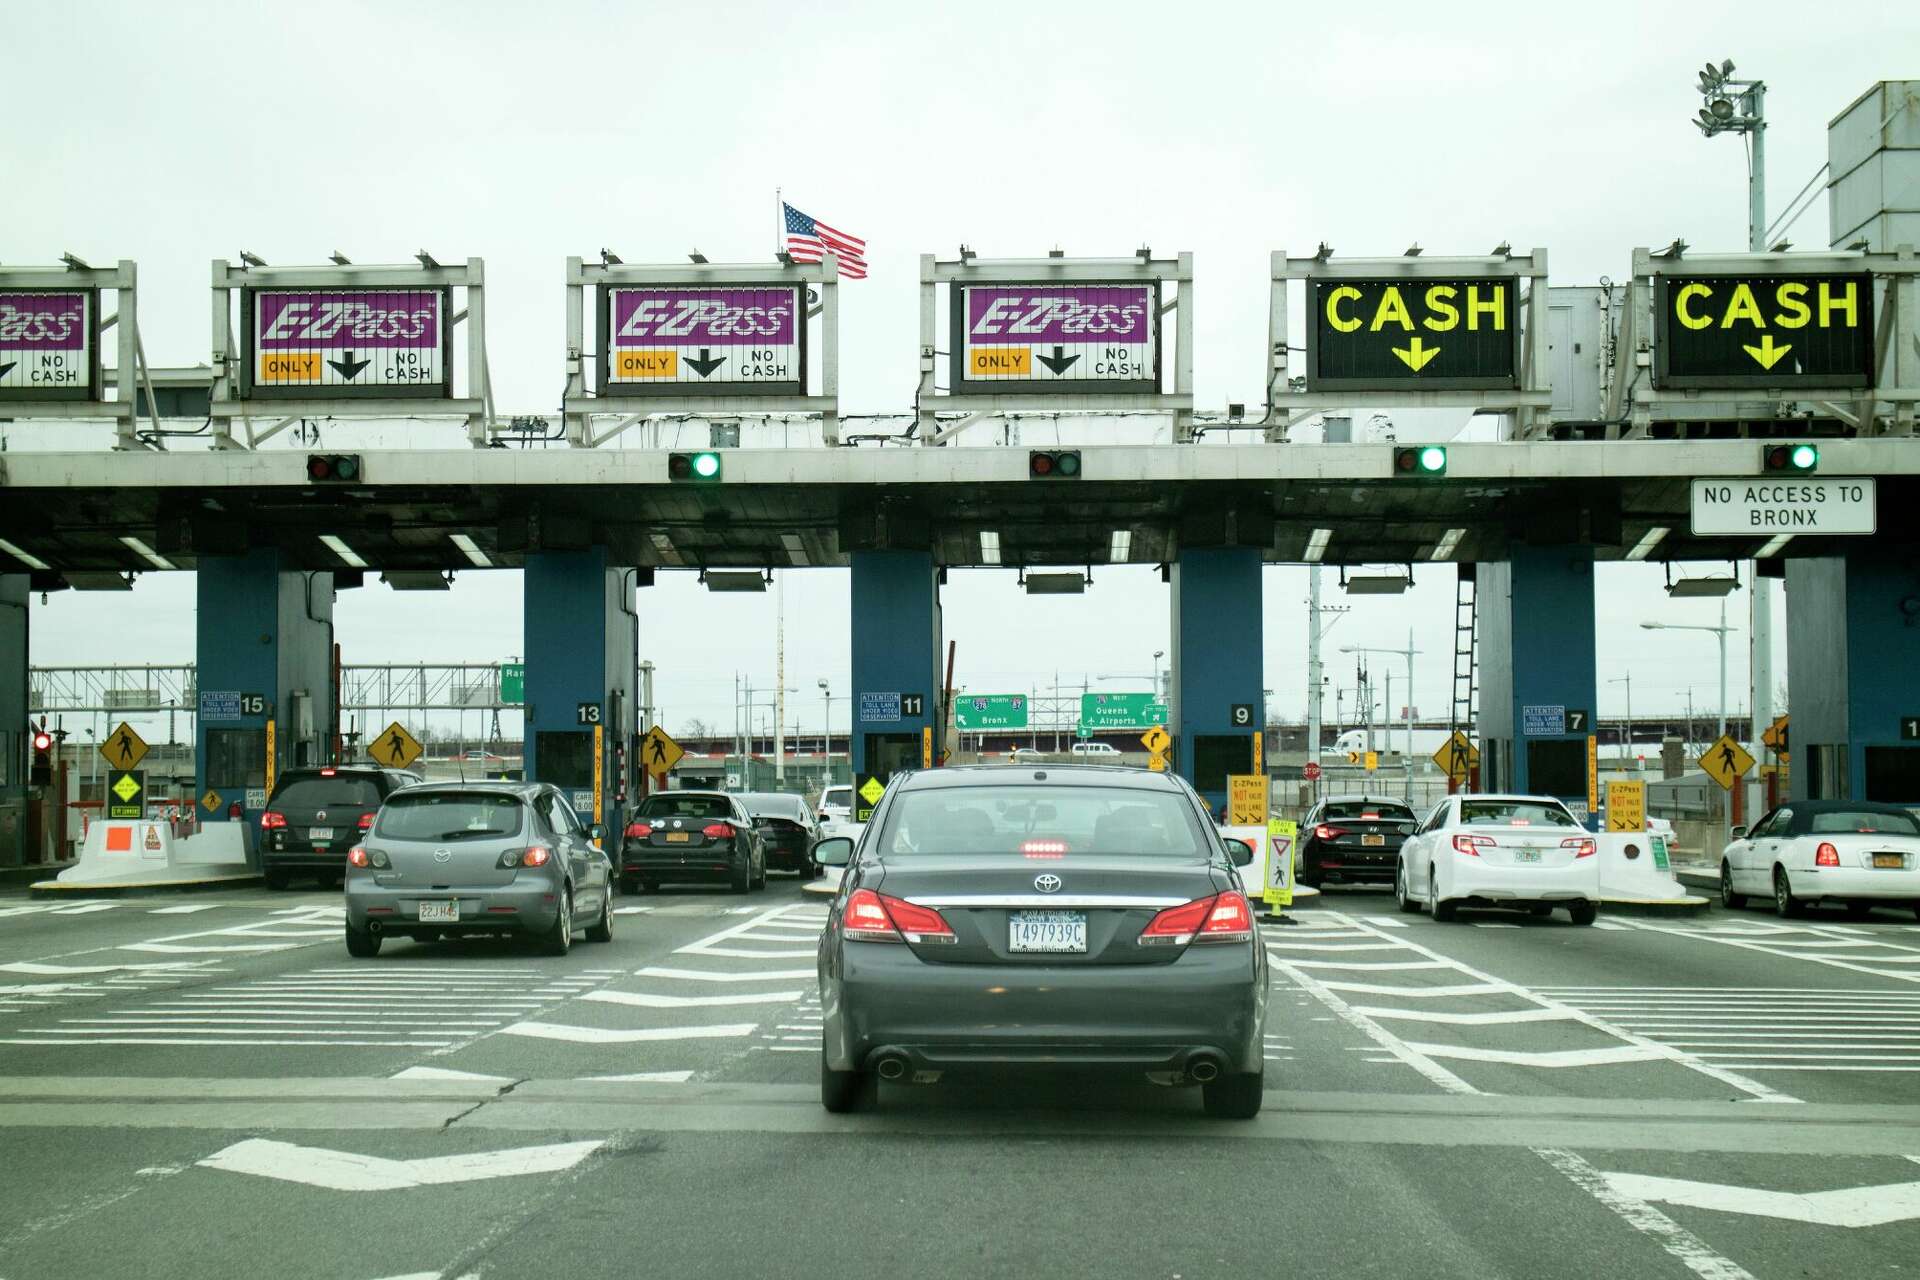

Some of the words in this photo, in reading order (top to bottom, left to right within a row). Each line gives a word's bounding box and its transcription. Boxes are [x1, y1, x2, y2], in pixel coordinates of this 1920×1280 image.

[1326, 286, 1505, 332] CASH
[1676, 282, 1858, 330] CASH
[396, 352, 417, 364] NO
[751, 350, 774, 362] NO
[1105, 348, 1128, 360] NO
[41, 355, 63, 367] NO
[268, 360, 314, 373] ONLY
[624, 358, 669, 370] ONLY
[977, 355, 1022, 368] ONLY
[385, 367, 430, 380] CASH
[740, 365, 787, 377] CASH
[1095, 362, 1141, 375] CASH
[31, 370, 77, 382] CASH
[1704, 487, 1731, 504] NO
[1743, 486, 1826, 503] ACCESS
[1838, 486, 1863, 503] TO
[1750, 509, 1817, 526] BRONX
[506, 669, 524, 678] Ran
[241, 697, 264, 713] 15
[904, 698, 921, 714] 11
[975, 702, 987, 710] 278
[1096, 707, 1128, 715] Queens
[577, 706, 600, 722] 13
[1235, 707, 1249, 724] 9
[1099, 718, 1136, 727] Airports
[1570, 713, 1583, 730] 7
[1908, 720, 1918, 737] 1
[1303, 767, 1320, 775] STOP
[575, 793, 593, 801] CARS
[1233, 790, 1247, 801] NOT
[1611, 796, 1626, 807] NOT
[1013, 923, 1081, 943] T497939C
